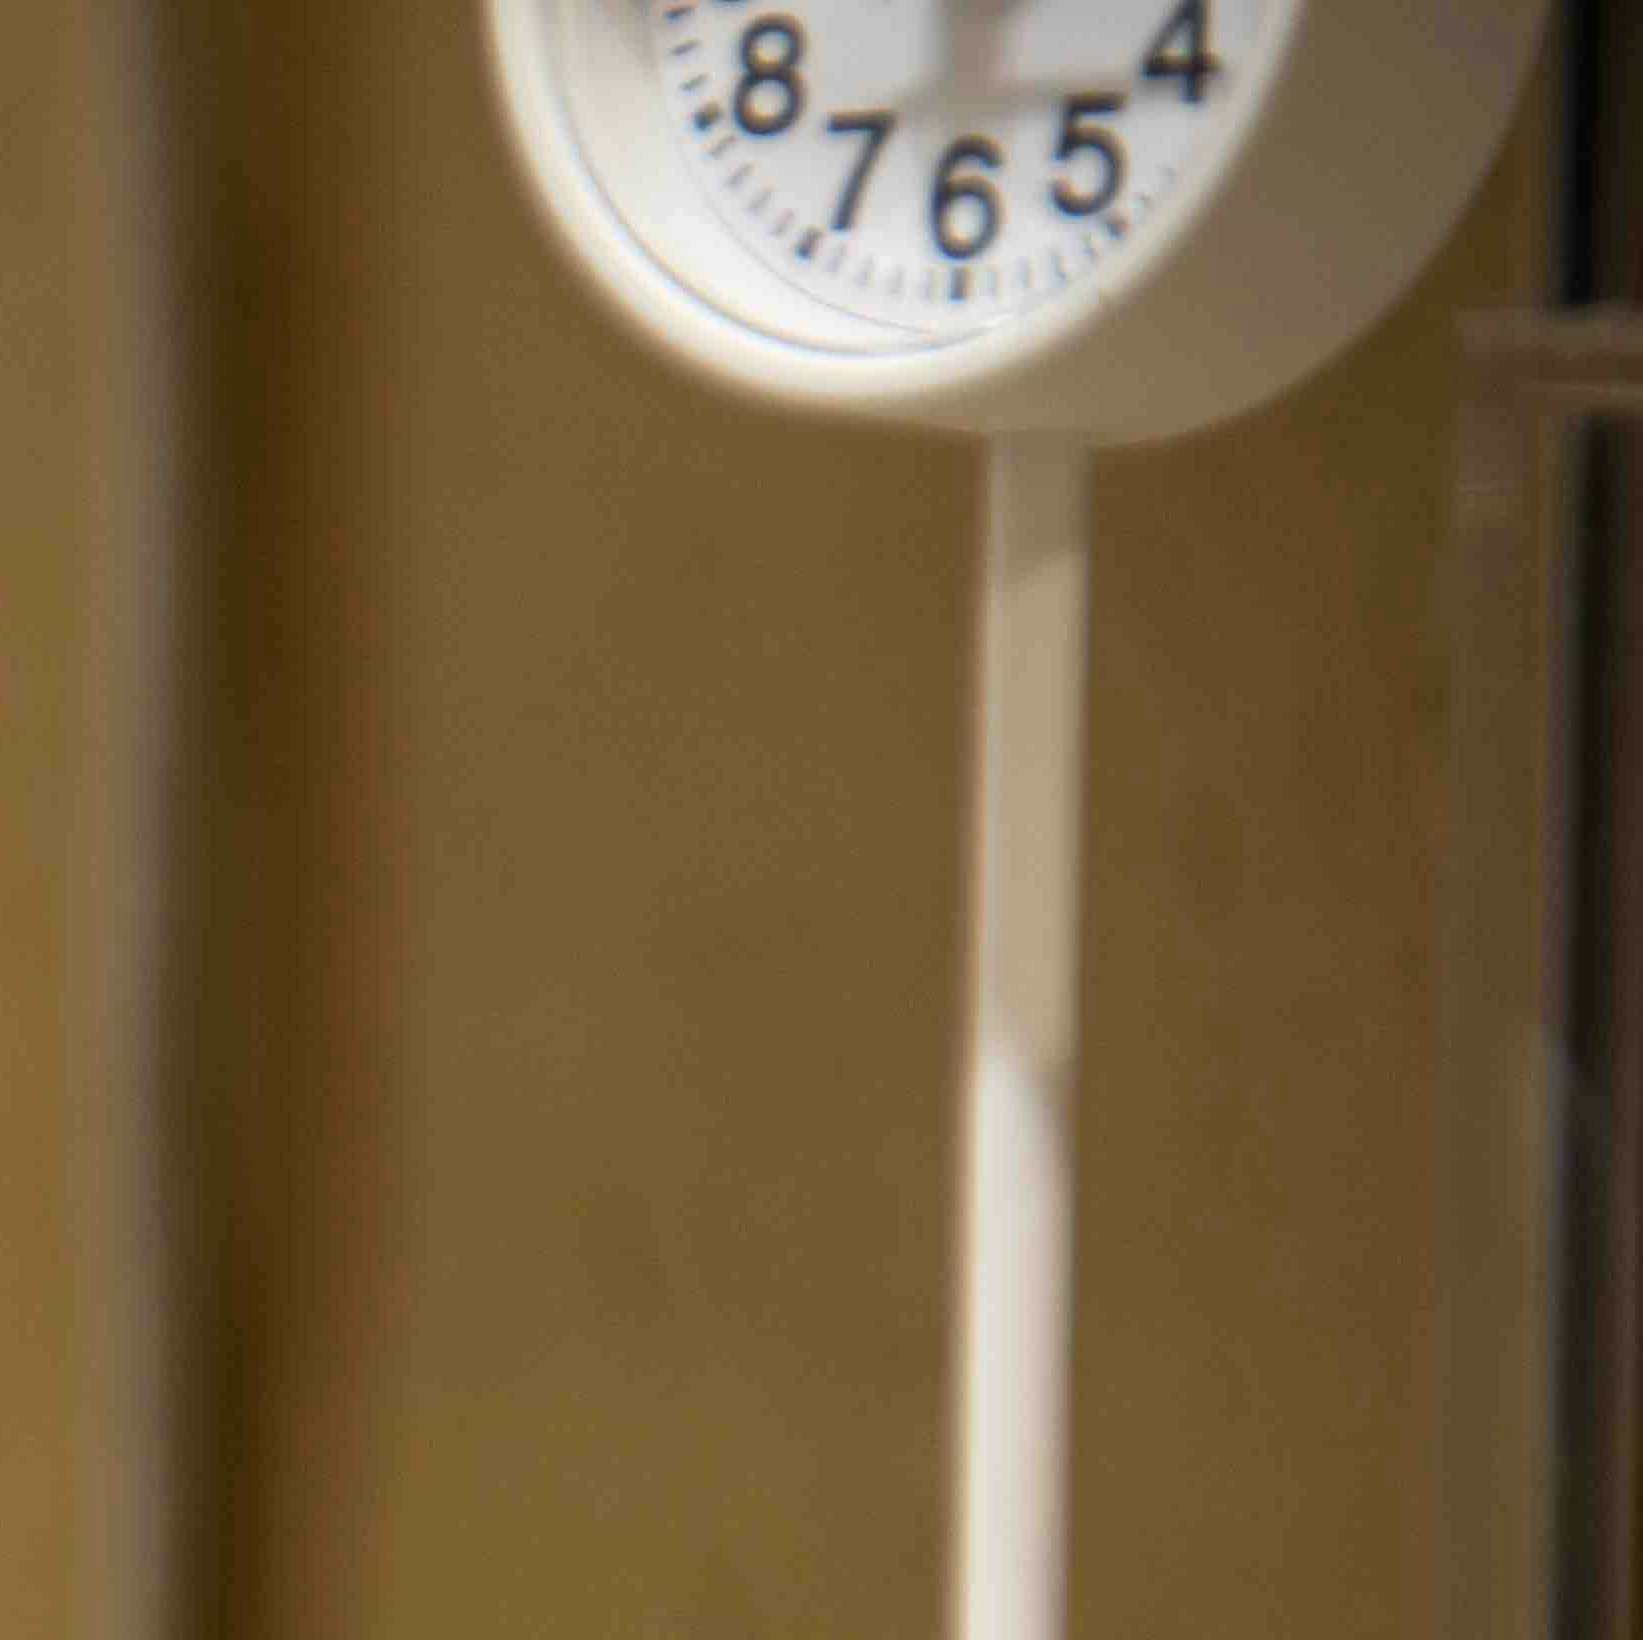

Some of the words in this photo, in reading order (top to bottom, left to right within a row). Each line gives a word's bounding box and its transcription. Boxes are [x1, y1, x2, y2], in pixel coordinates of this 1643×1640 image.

[731, 15, 805, 137] 8
[825, 108, 901, 231] 7
[929, 133, 1003, 260] 6
[1051, 90, 1127, 217] 5
